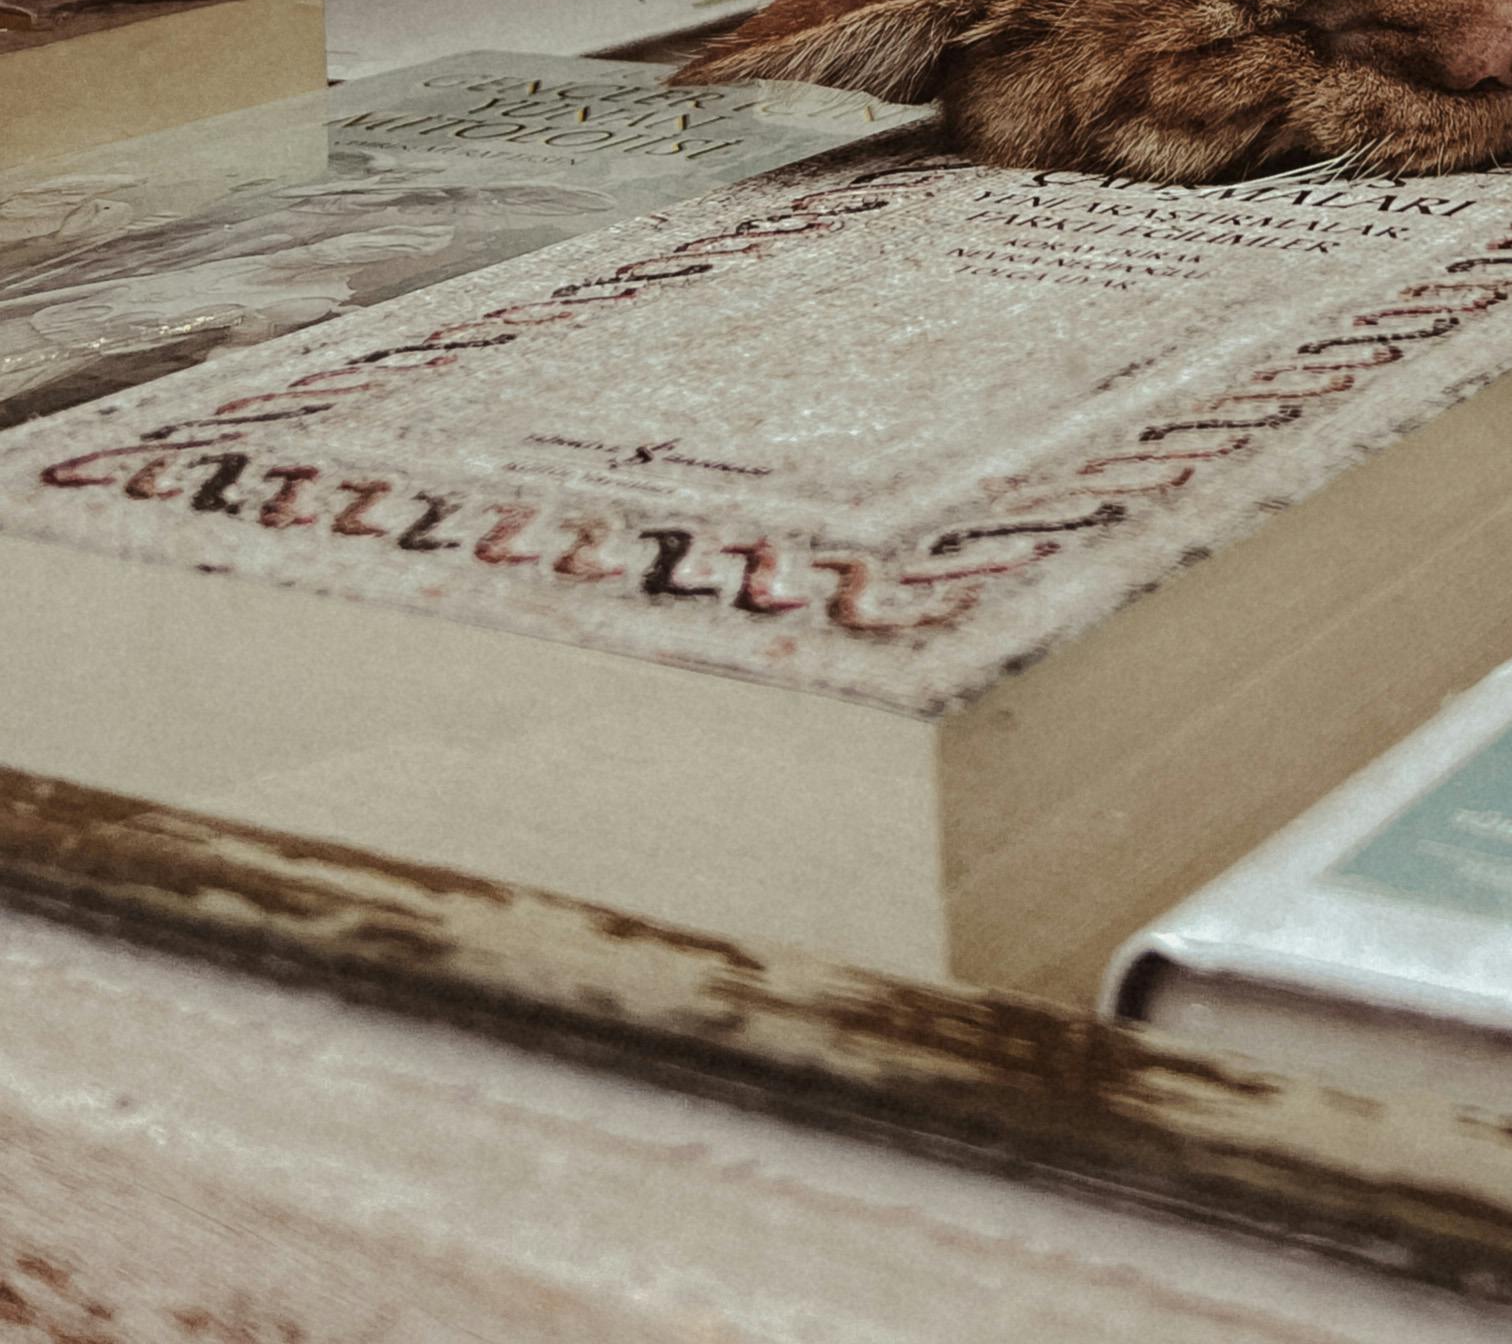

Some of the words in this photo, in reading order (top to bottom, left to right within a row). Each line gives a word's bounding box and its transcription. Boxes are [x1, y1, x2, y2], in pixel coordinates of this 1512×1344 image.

[422, 72, 726, 110] GENÇLER
[468, 97, 733, 133] YUNAN
[324, 111, 744, 161] MİTOLOJİSİ
